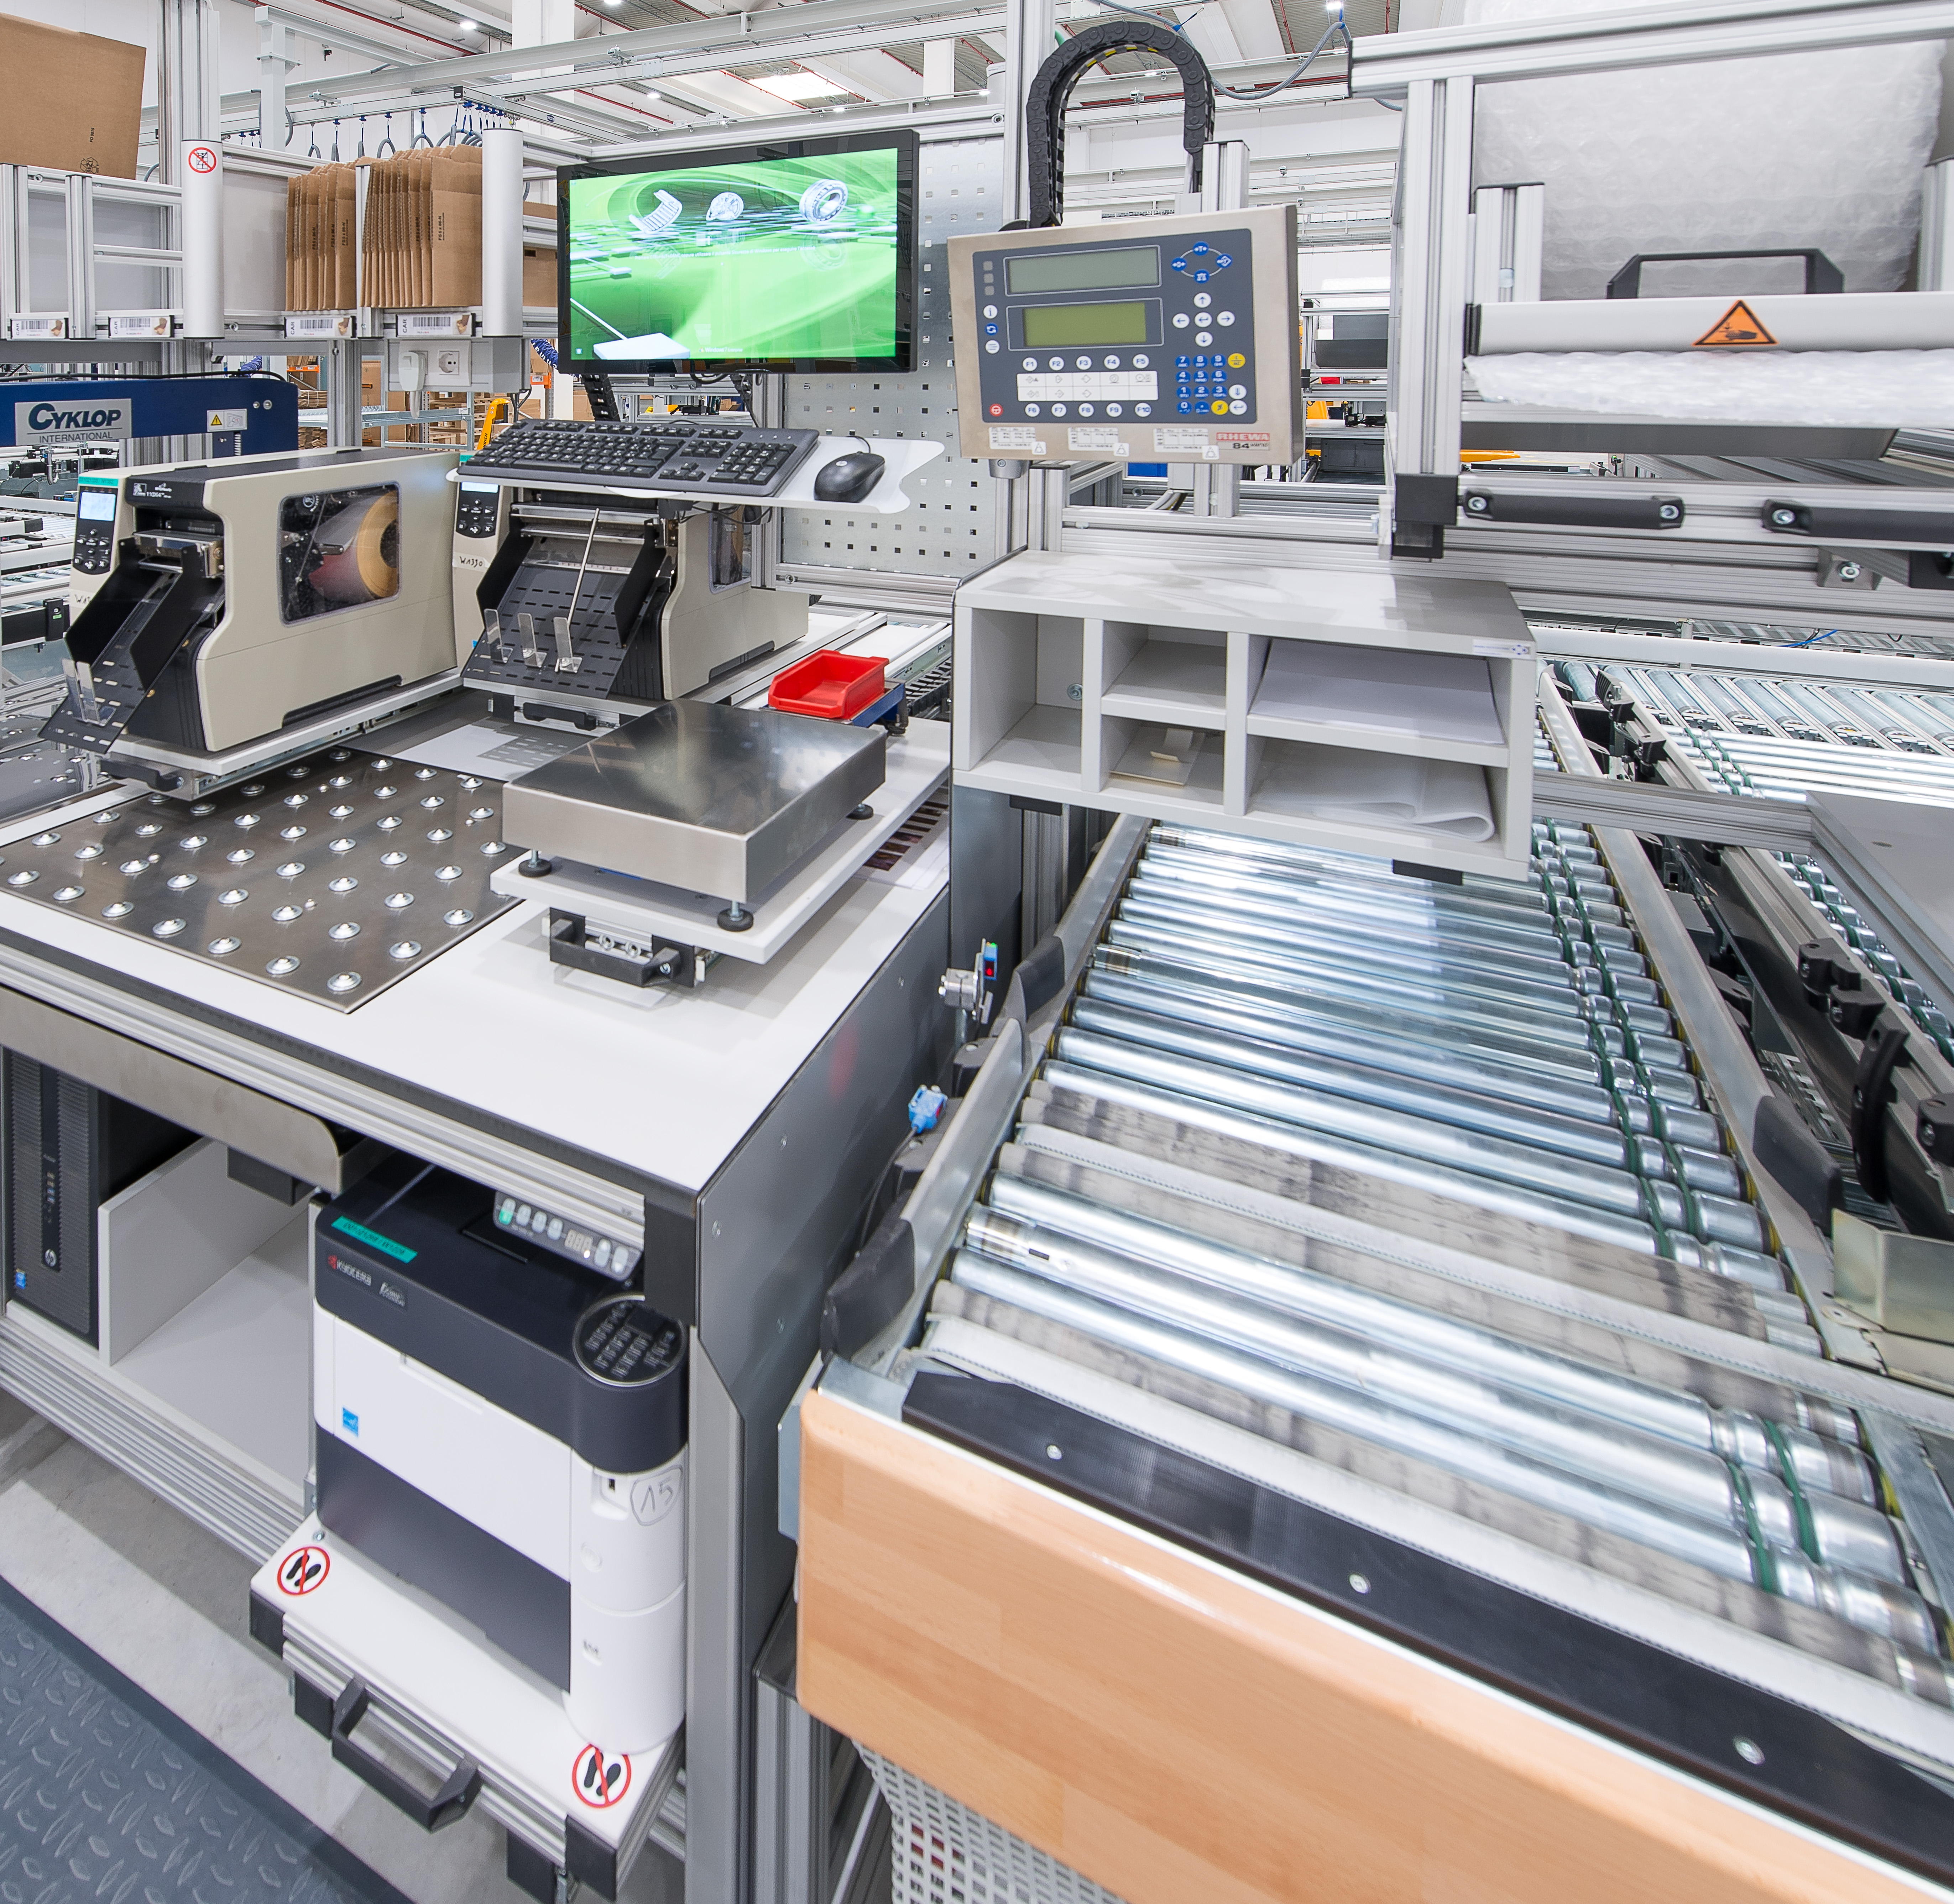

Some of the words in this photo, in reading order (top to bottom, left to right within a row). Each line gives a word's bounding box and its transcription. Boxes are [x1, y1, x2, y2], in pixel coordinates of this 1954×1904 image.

[28, 403, 121, 430] CYKLOP
[39, 431, 113, 443] INTERNATIONAL
[1218, 433, 1269, 441] RHEWA
[337, 1259, 372, 1286] KYOCERA
